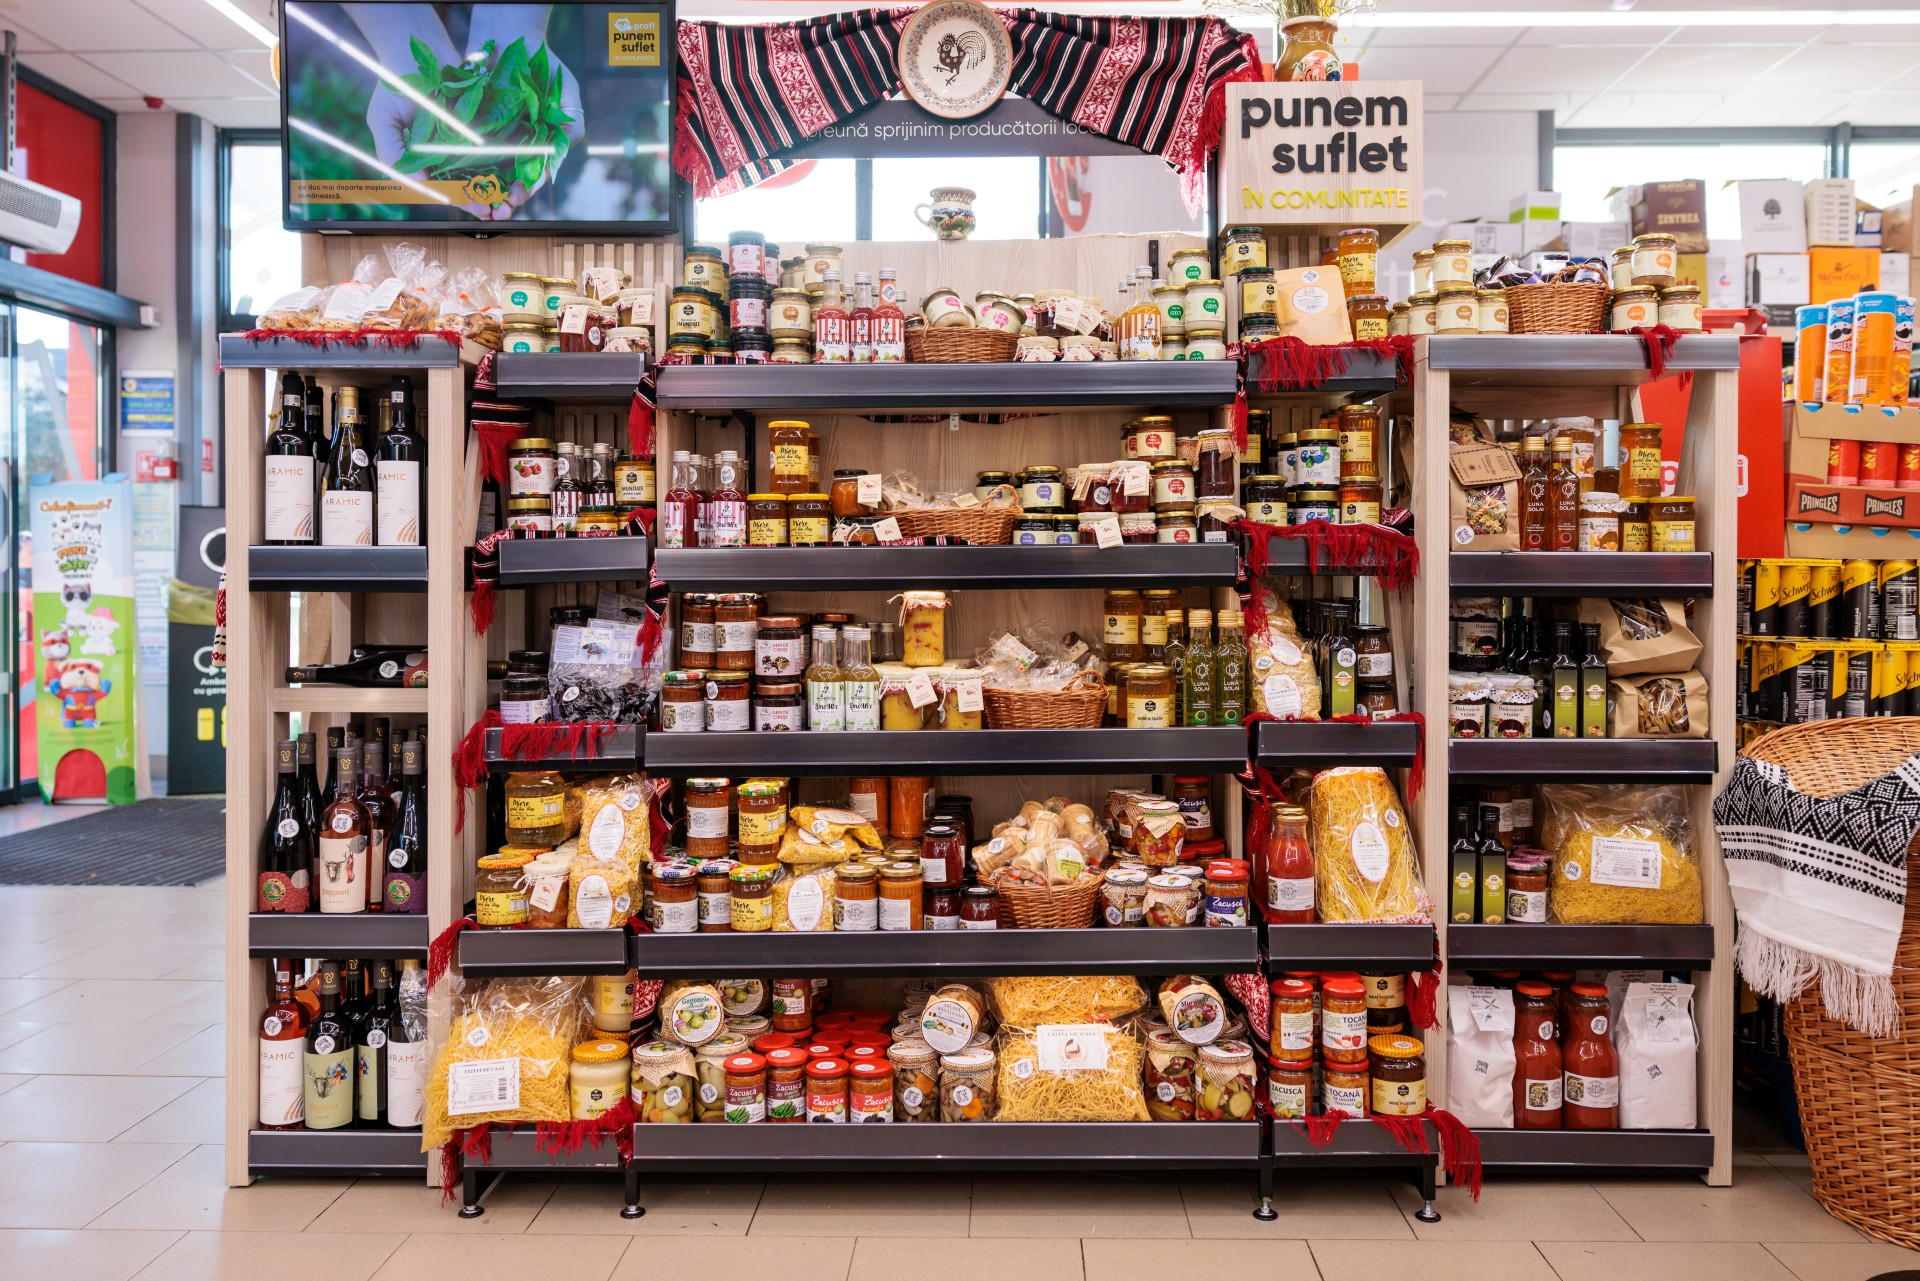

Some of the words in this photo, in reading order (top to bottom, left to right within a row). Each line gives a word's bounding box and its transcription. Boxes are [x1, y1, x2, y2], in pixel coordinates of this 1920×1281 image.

[634, 21, 655, 31] profi
[613, 32, 655, 43] punem
[621, 42, 655, 53] suflet
[1241, 95, 1408, 139] punem
[806, 121, 868, 141] preună
[874, 119, 944, 142] sprijinim
[949, 118, 1058, 139] producătorii
[1271, 131, 1408, 174] suflet
[308, 183, 321, 192] duc
[322, 183, 335, 192] mai
[336, 183, 364, 194] departe
[1241, 185, 1264, 209] ÎN
[1270, 188, 1409, 209] COMUNITATE
[1801, 494, 1838, 512] PRINGLES
[1866, 497, 1903, 516] PRINGLES
[200, 677, 226, 687] Amba
[204, 688, 226, 697] gara
[1212, 896, 1243, 908] Zacuscă
[1342, 1015, 1366, 1024] TOCAN
[389, 1054, 414, 1062] ARAM
[730, 1088, 757, 1096] Zacuscă
[1272, 1084, 1302, 1094] ZACUSCĂ
[1330, 1088, 1360, 1098] TOCANĂ
